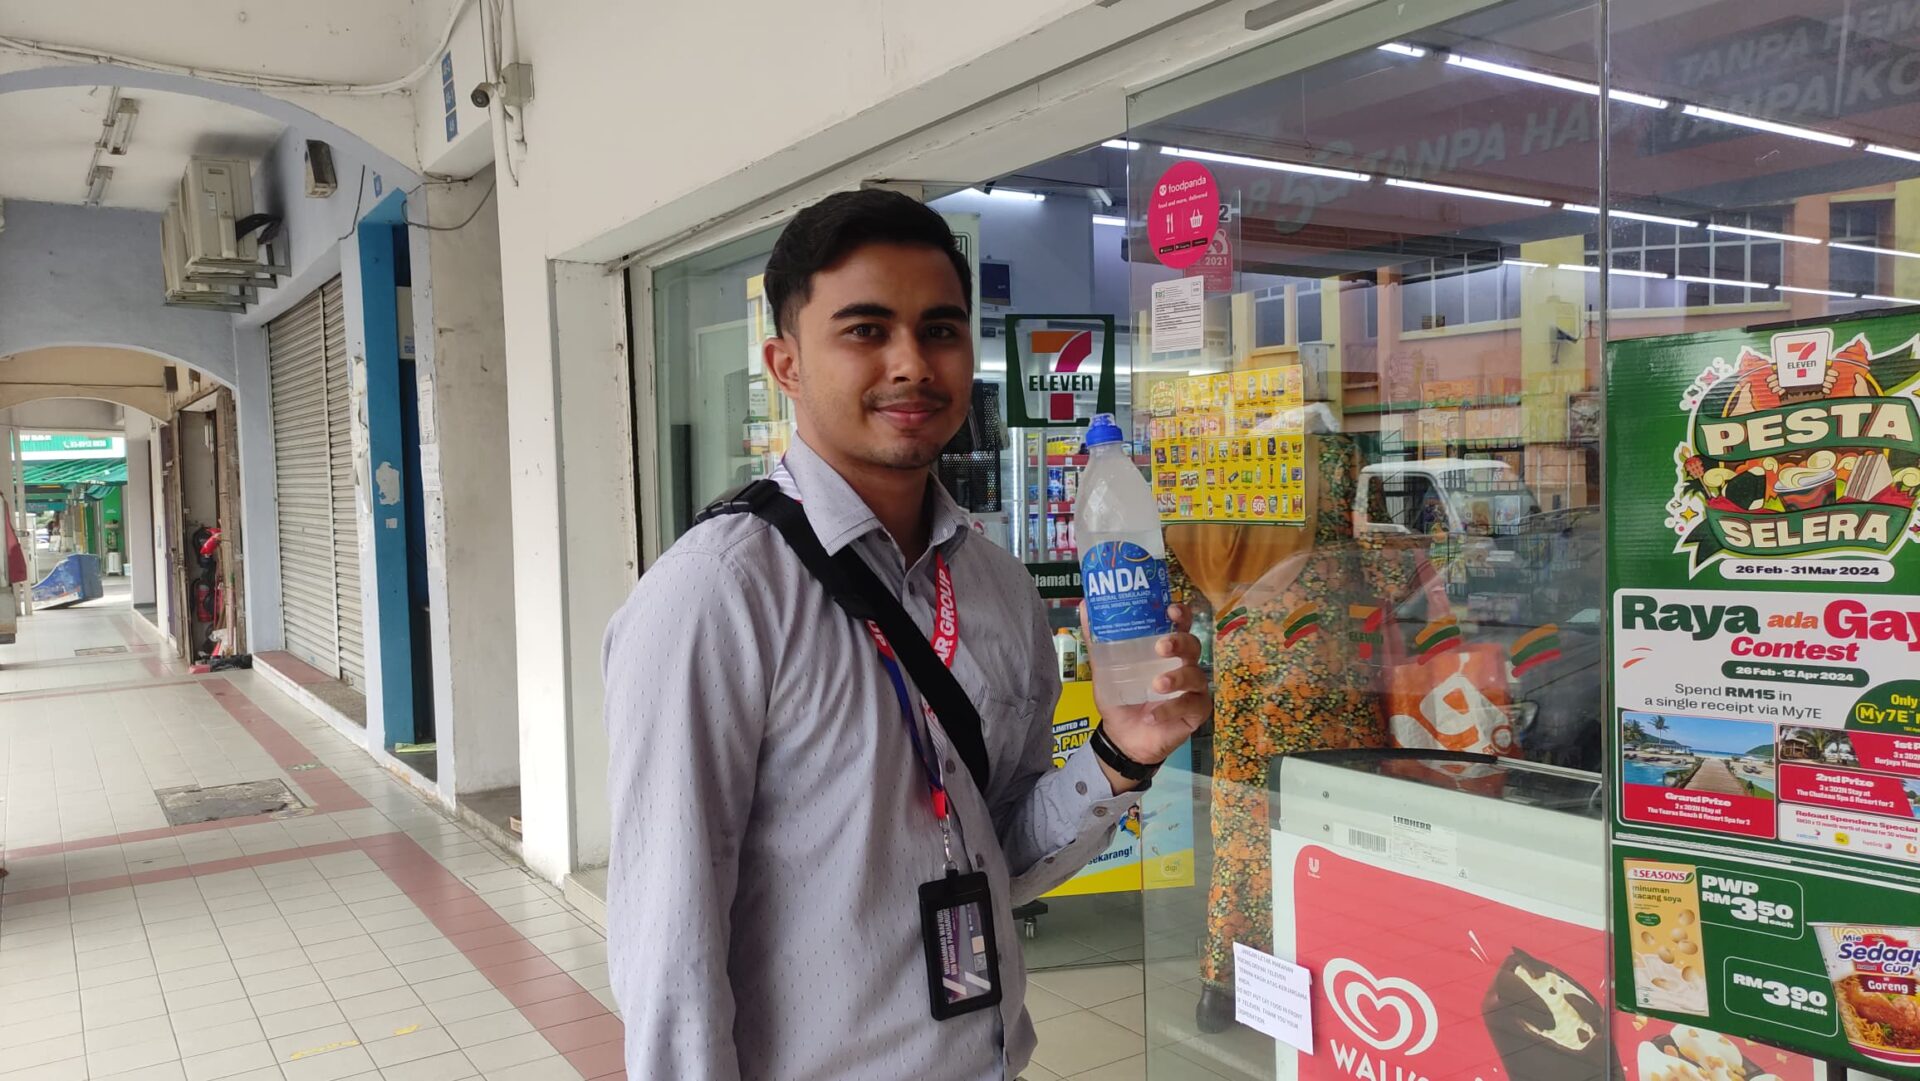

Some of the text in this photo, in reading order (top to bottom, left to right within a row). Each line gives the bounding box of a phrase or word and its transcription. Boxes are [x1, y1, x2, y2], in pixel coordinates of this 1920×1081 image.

[1168, 175, 1207, 193] foodpanda
[1205, 257, 1228, 266] 2021
[1701, 403, 1914, 456] PESTA
[1718, 513, 1891, 549] SELERA
[1736, 565, 1880, 577] 26 Feb 31 Mar 2024
[1035, 574, 1070, 587] lamat
[1088, 566, 1150, 597] ANDA
[939, 568, 955, 637] GROUP
[1621, 595, 1760, 641] Raya
[1767, 611, 1819, 629] ada
[1730, 636, 1860, 662] Contest
[1735, 666, 1854, 682] 26 Feb 12 Apr 2024
[1674, 683, 1792, 701] Spend RM15 in
[1656, 697, 1698, 713] single
[1700, 701, 1754, 716] receipt
[1758, 704, 1779, 715] via
[1782, 706, 1822, 720] My7E
[1890, 694, 1918, 709] Only
[1053, 721, 1078, 733] LIMITED
[1816, 773, 1875, 787] 2nd Prize
[1665, 792, 1732, 807] Grand Prize
[1836, 794, 1849, 802] Spa
[1855, 797, 1878, 806] Resort
[1848, 788, 1862, 797] Stay
[1393, 815, 1432, 831] LIEBHERR
[1703, 813, 1724, 821] Resort
[1796, 810, 1918, 833] Reload Spenders Special
[1639, 869, 1685, 880] SEASONS
[1701, 875, 1759, 895] PWP
[1663, 895, 1682, 903] soya
[1768, 918, 1794, 928] each
[1884, 963, 1910, 975] Cup
[1868, 980, 1909, 994] Goreng
[1802, 1005, 1828, 1016] each
